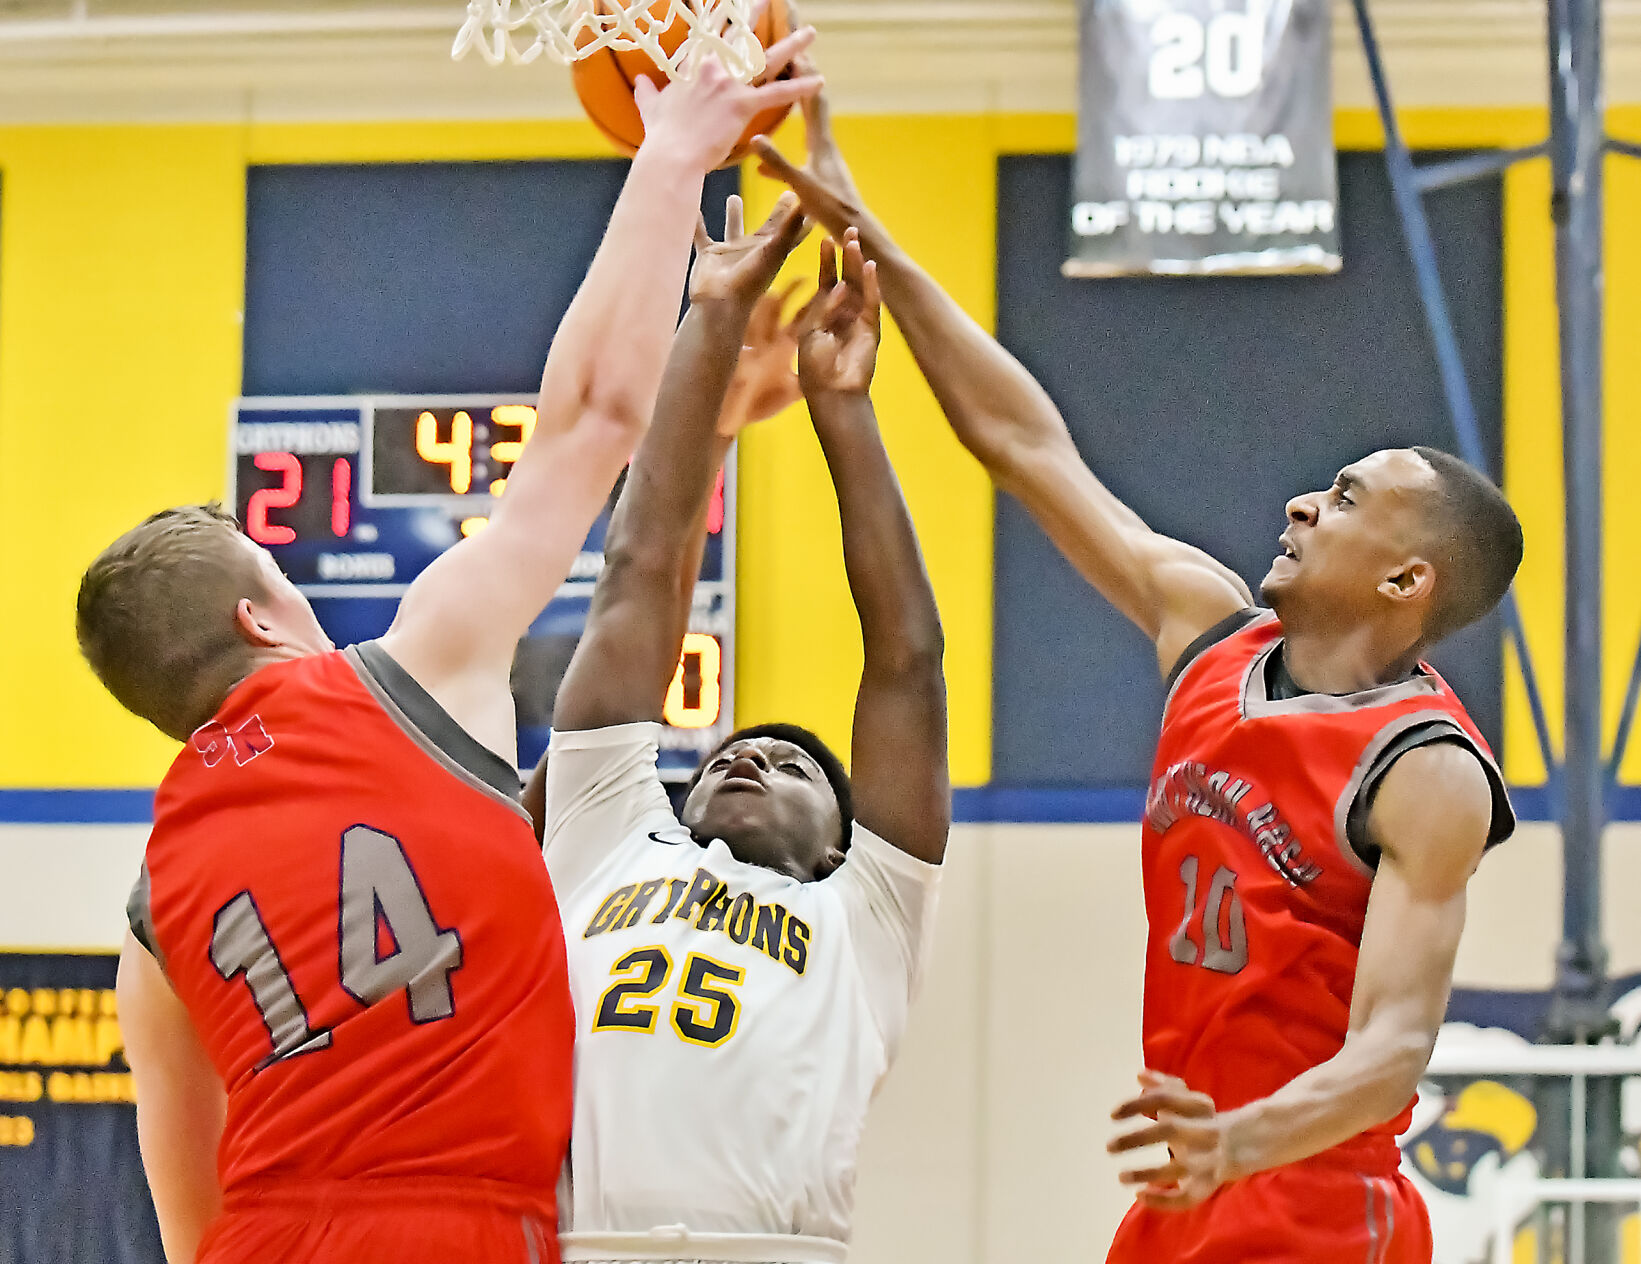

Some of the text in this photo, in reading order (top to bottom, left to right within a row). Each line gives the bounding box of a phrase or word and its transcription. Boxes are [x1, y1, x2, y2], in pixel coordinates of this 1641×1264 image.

[1149, 11, 1262, 99] 20
[1114, 133, 1295, 168] 1979 NBA
[1126, 168, 1280, 200] ROOKIE
[1072, 200, 1335, 236] OF THE YEAR
[237, 421, 361, 455] GRYPHONS
[247, 451, 351, 545] 21
[208, 823, 464, 1075] 14
[582, 867, 813, 977] GRYPHONS
[1169, 854, 1249, 975] 10
[592, 944, 747, 1050] 25
